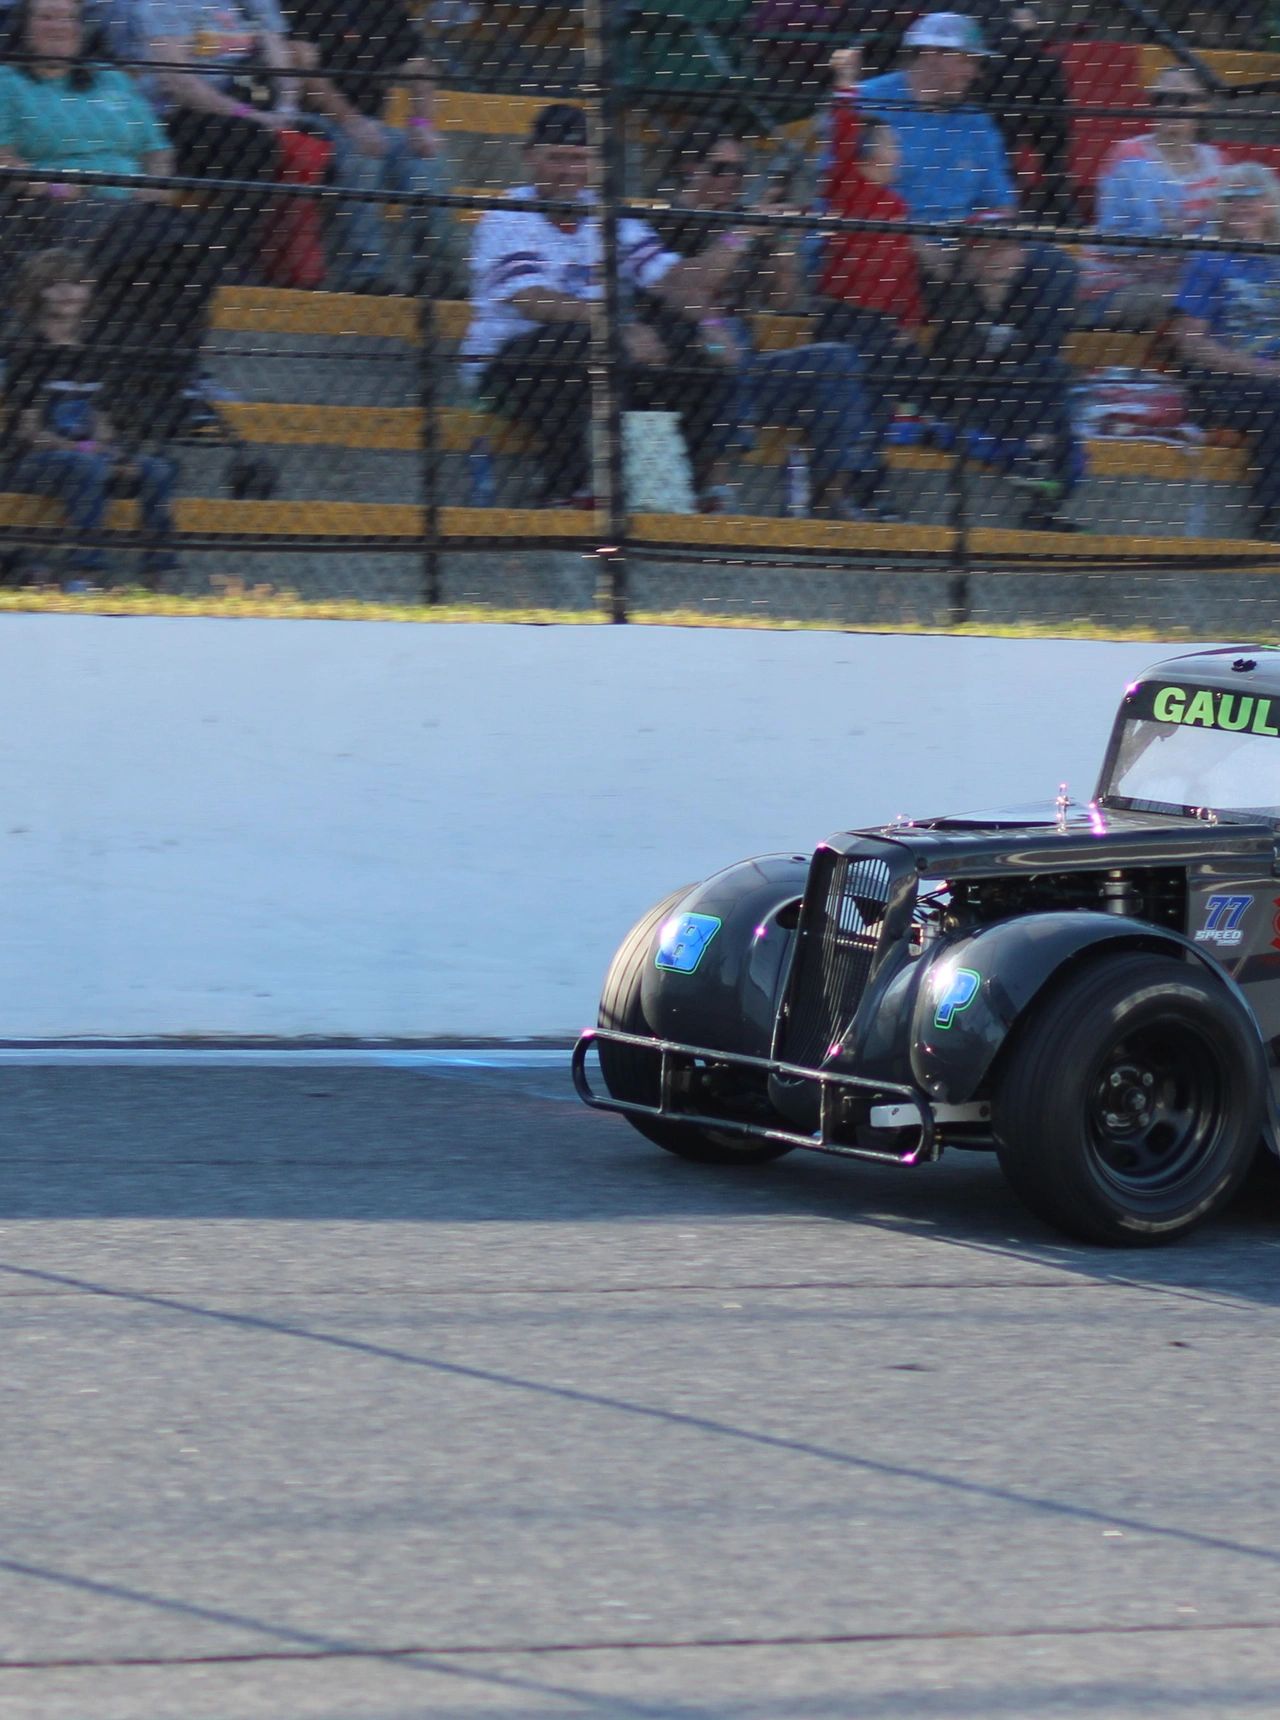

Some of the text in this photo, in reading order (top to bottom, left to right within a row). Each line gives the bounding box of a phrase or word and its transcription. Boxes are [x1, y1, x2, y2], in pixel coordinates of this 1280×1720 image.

[1153, 686, 1279, 736] GAUL
[1205, 894, 1255, 931] 77
[1194, 930, 1245, 941] SPEED
